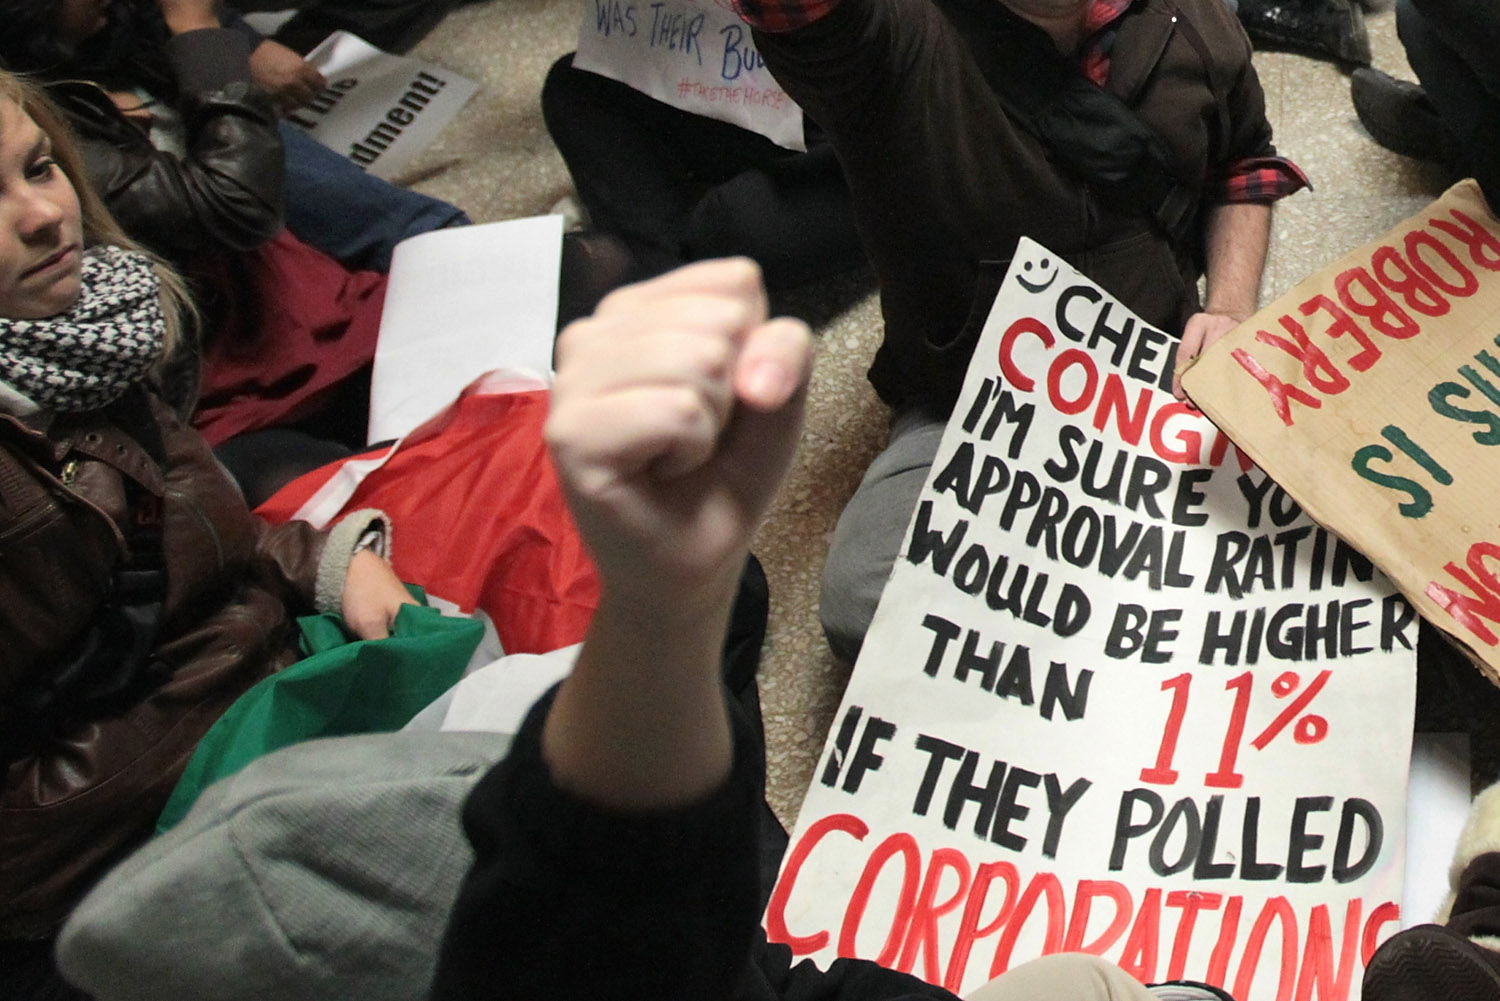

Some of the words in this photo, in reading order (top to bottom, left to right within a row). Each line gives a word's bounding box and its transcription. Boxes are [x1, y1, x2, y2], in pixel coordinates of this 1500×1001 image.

[650, 2, 705, 66] THEIR
[351, 70, 447, 170] dment!
[933, 441, 1194, 592] APPROVAL
[1204, 524, 1374, 600] RATIN
[963, 376, 1036, 460] I'M
[1045, 425, 1213, 528] SURE
[1237, 472, 1302, 529] YO
[1351, 424, 1454, 519] IS
[906, 501, 1092, 637] WOULD
[1104, 604, 1183, 663] BE
[1199, 594, 1417, 665] HIGHER
[920, 614, 1095, 721] THAN
[1139, 669, 1333, 788] 11%
[821, 705, 897, 794] IF
[913, 733, 1093, 860] THEY
[1108, 788, 1384, 883] POLLED
